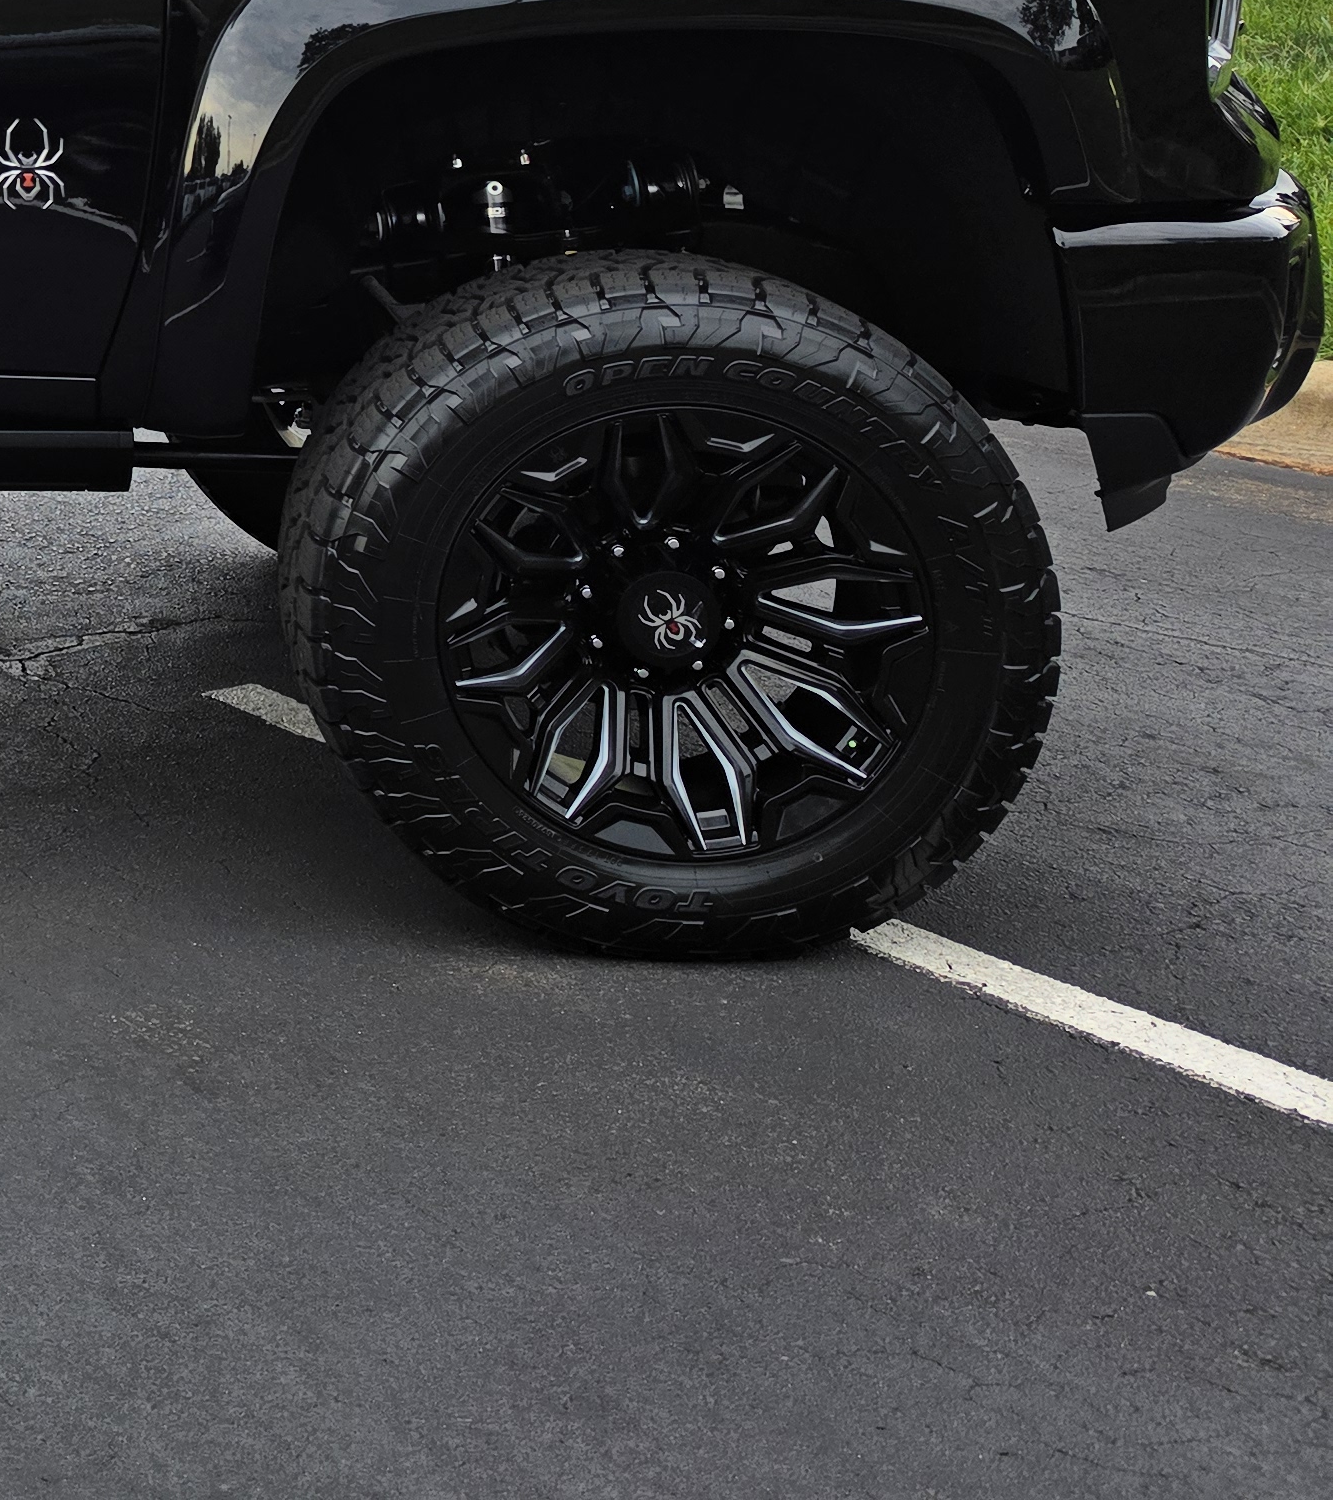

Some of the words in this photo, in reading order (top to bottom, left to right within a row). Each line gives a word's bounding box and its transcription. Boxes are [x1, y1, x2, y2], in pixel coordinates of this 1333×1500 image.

[562, 354, 715, 397] OPEN
[723, 359, 948, 495] COUNTRY
[554, 863, 716, 915] TOYO
